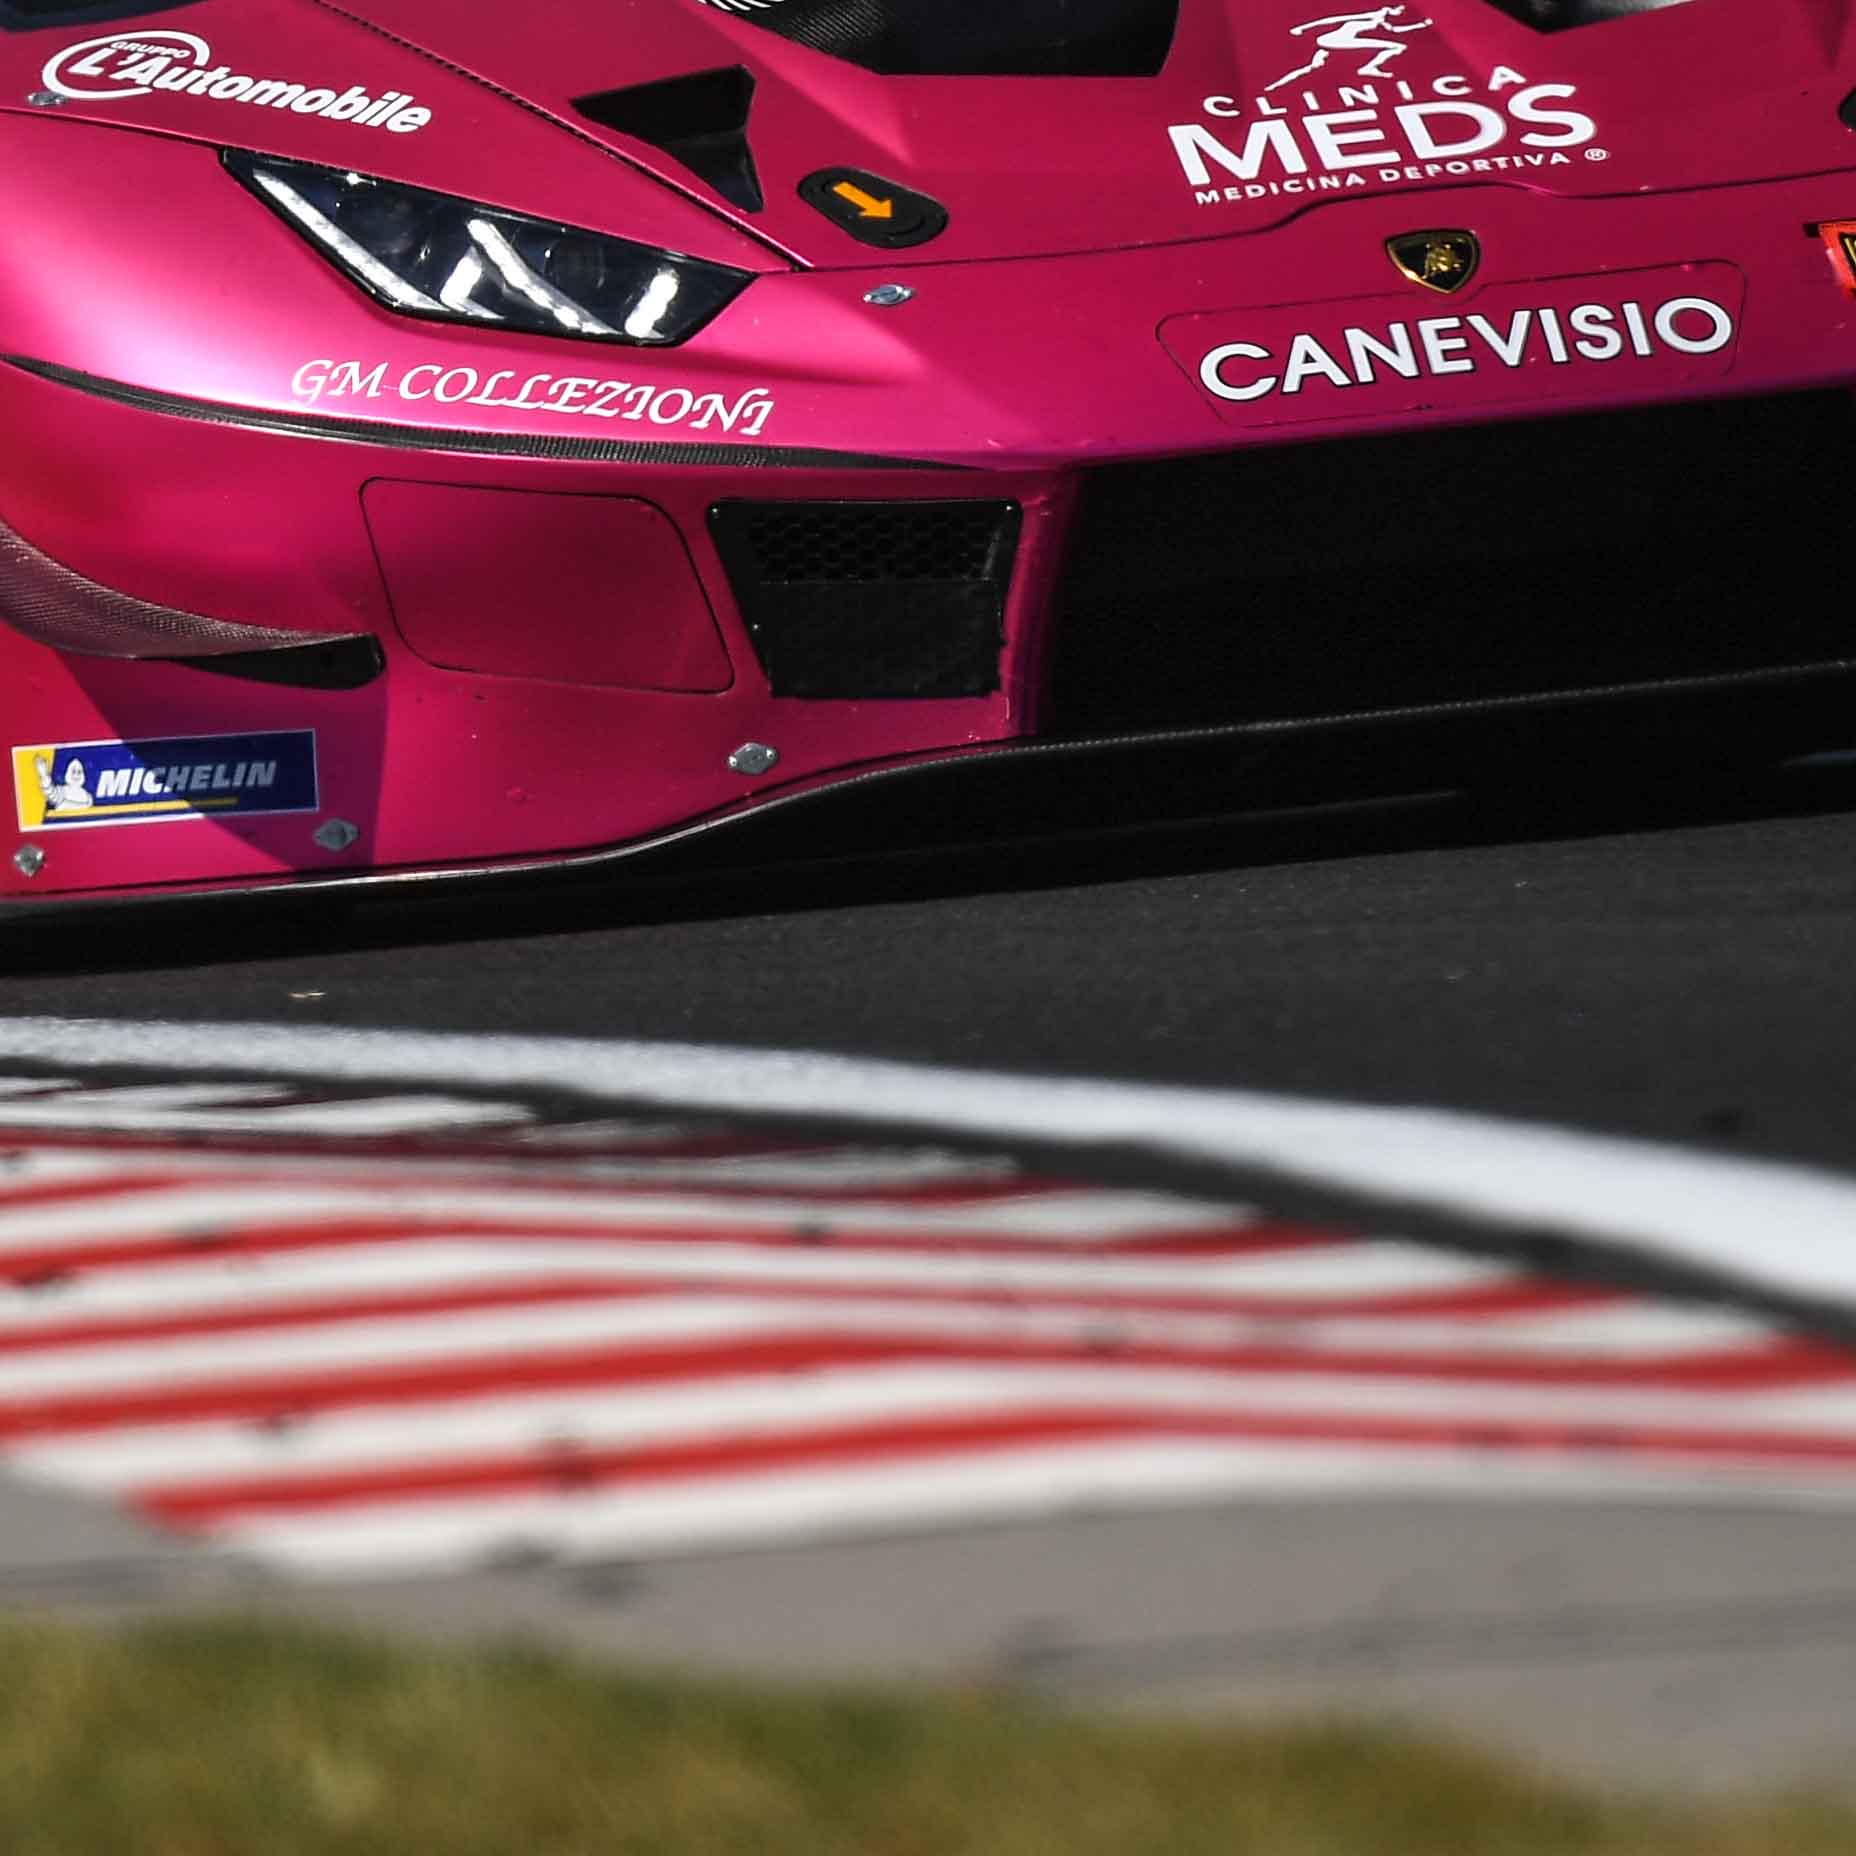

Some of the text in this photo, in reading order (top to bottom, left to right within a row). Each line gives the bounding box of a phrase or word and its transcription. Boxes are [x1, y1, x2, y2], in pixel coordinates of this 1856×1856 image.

[110, 40, 190, 58] GRUPPO
[68, 46, 432, 133] L'Automobile
[1203, 65, 1526, 118] CLINICA
[1168, 84, 1597, 186] MEDS
[1195, 151, 1571, 205] MEDICINA DEPORTIVA
[1199, 296, 1733, 401] CANEVISIO
[291, 359, 775, 437] GM COLLEZIONI
[95, 759, 277, 799] MICHELIN
